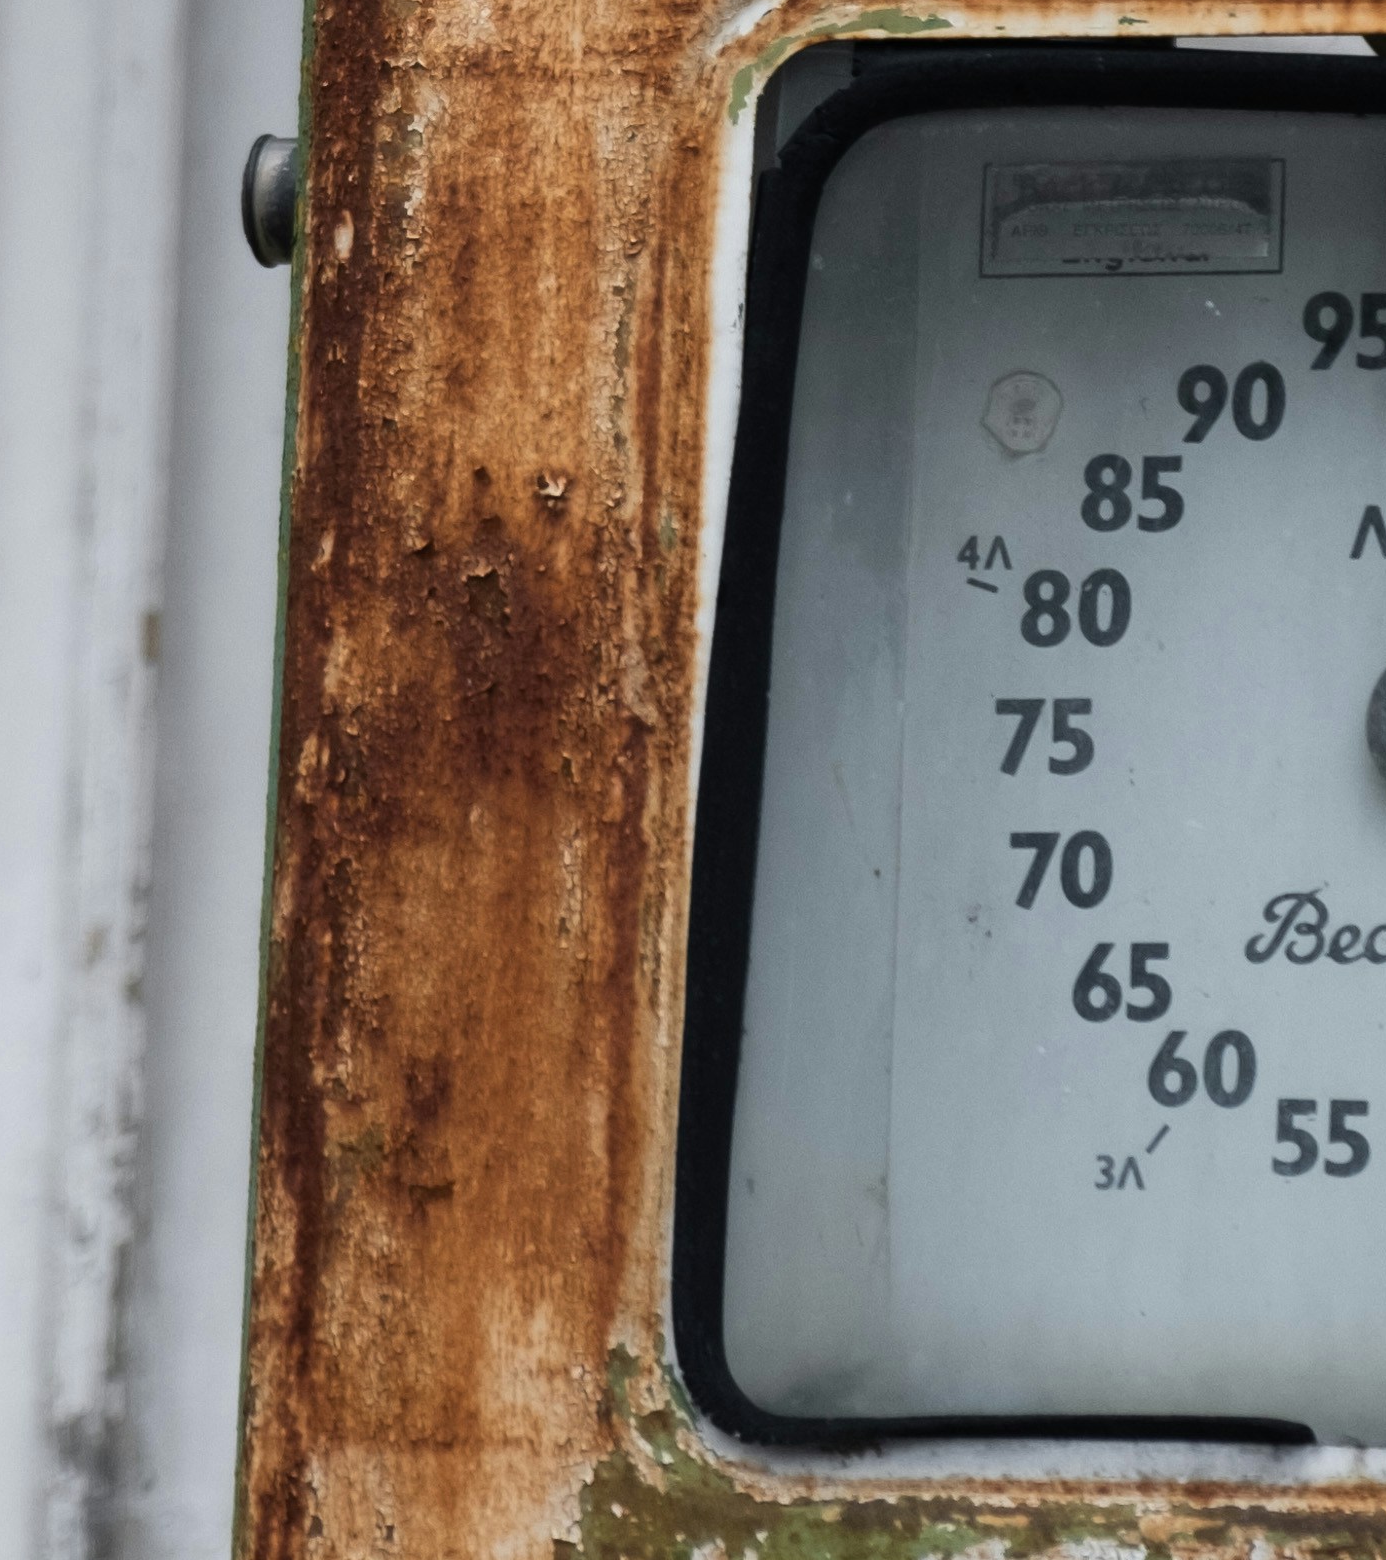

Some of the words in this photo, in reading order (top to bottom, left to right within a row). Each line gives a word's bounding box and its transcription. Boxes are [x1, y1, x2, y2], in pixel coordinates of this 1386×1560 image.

[1176, 361, 1286, 443] 90
[1081, 453, 1184, 532] 85
[1020, 568, 1131, 647] 80
[995, 698, 1094, 776] 75
[1009, 830, 1113, 909] 70
[1072, 942, 1172, 1022] 65
[1147, 1029, 1257, 1108] 60
[1272, 1098, 1370, 1177] 55
